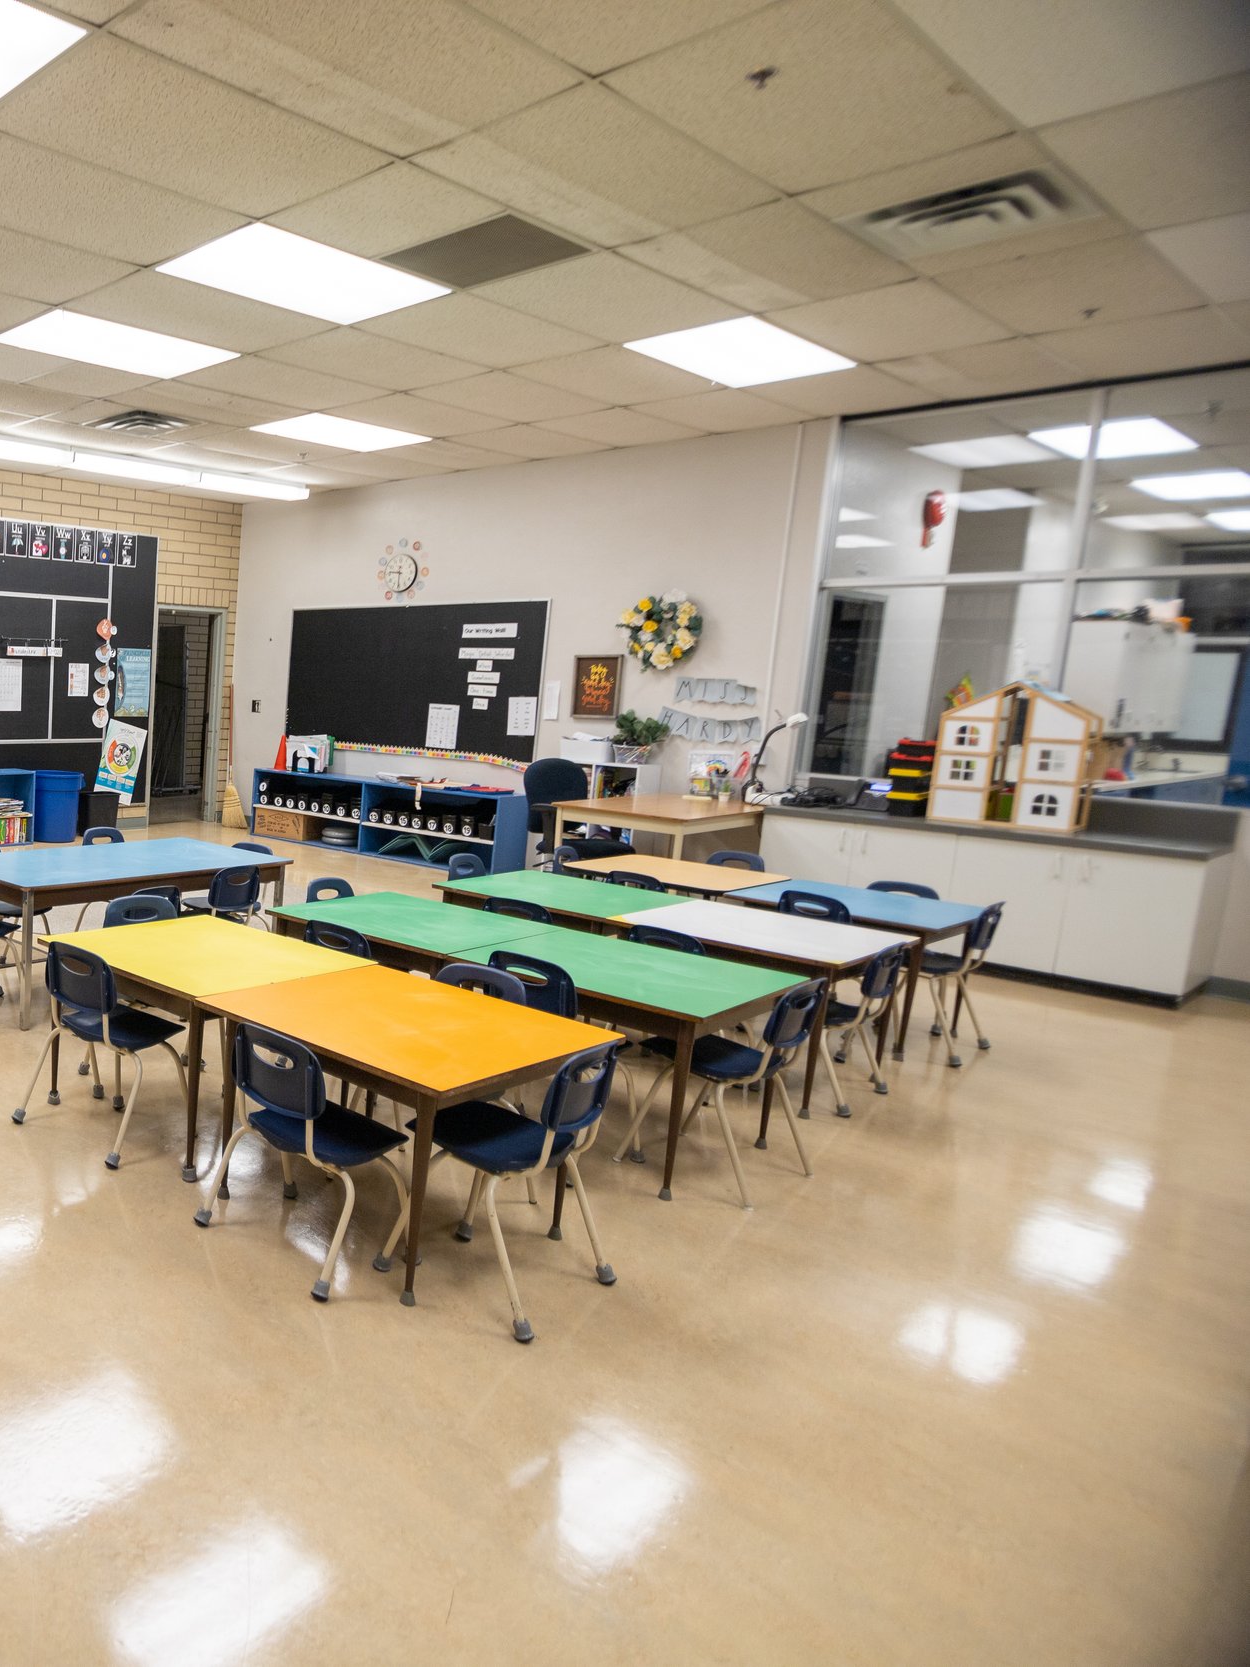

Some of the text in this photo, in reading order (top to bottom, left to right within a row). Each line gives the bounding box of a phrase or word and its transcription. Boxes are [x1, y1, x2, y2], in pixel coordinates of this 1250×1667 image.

[11, 522, 23, 534] Uu
[35, 525, 46, 536] Vv
[56, 527, 71, 539] Ww
[80, 530, 91, 541] Xx
[102, 533, 112, 546] Yy
[123, 535, 132, 546] Zz
[475, 627, 493, 635] Writing
[676, 680, 748, 701] MISS
[661, 710, 754, 739] HARDY
[338, 807, 344, 815] 11
[370, 813, 377, 821] 13
[384, 815, 391, 823] 14
[400, 817, 407, 825] 15
[428, 822, 436, 830] 17
[463, 827, 470, 835] 19
